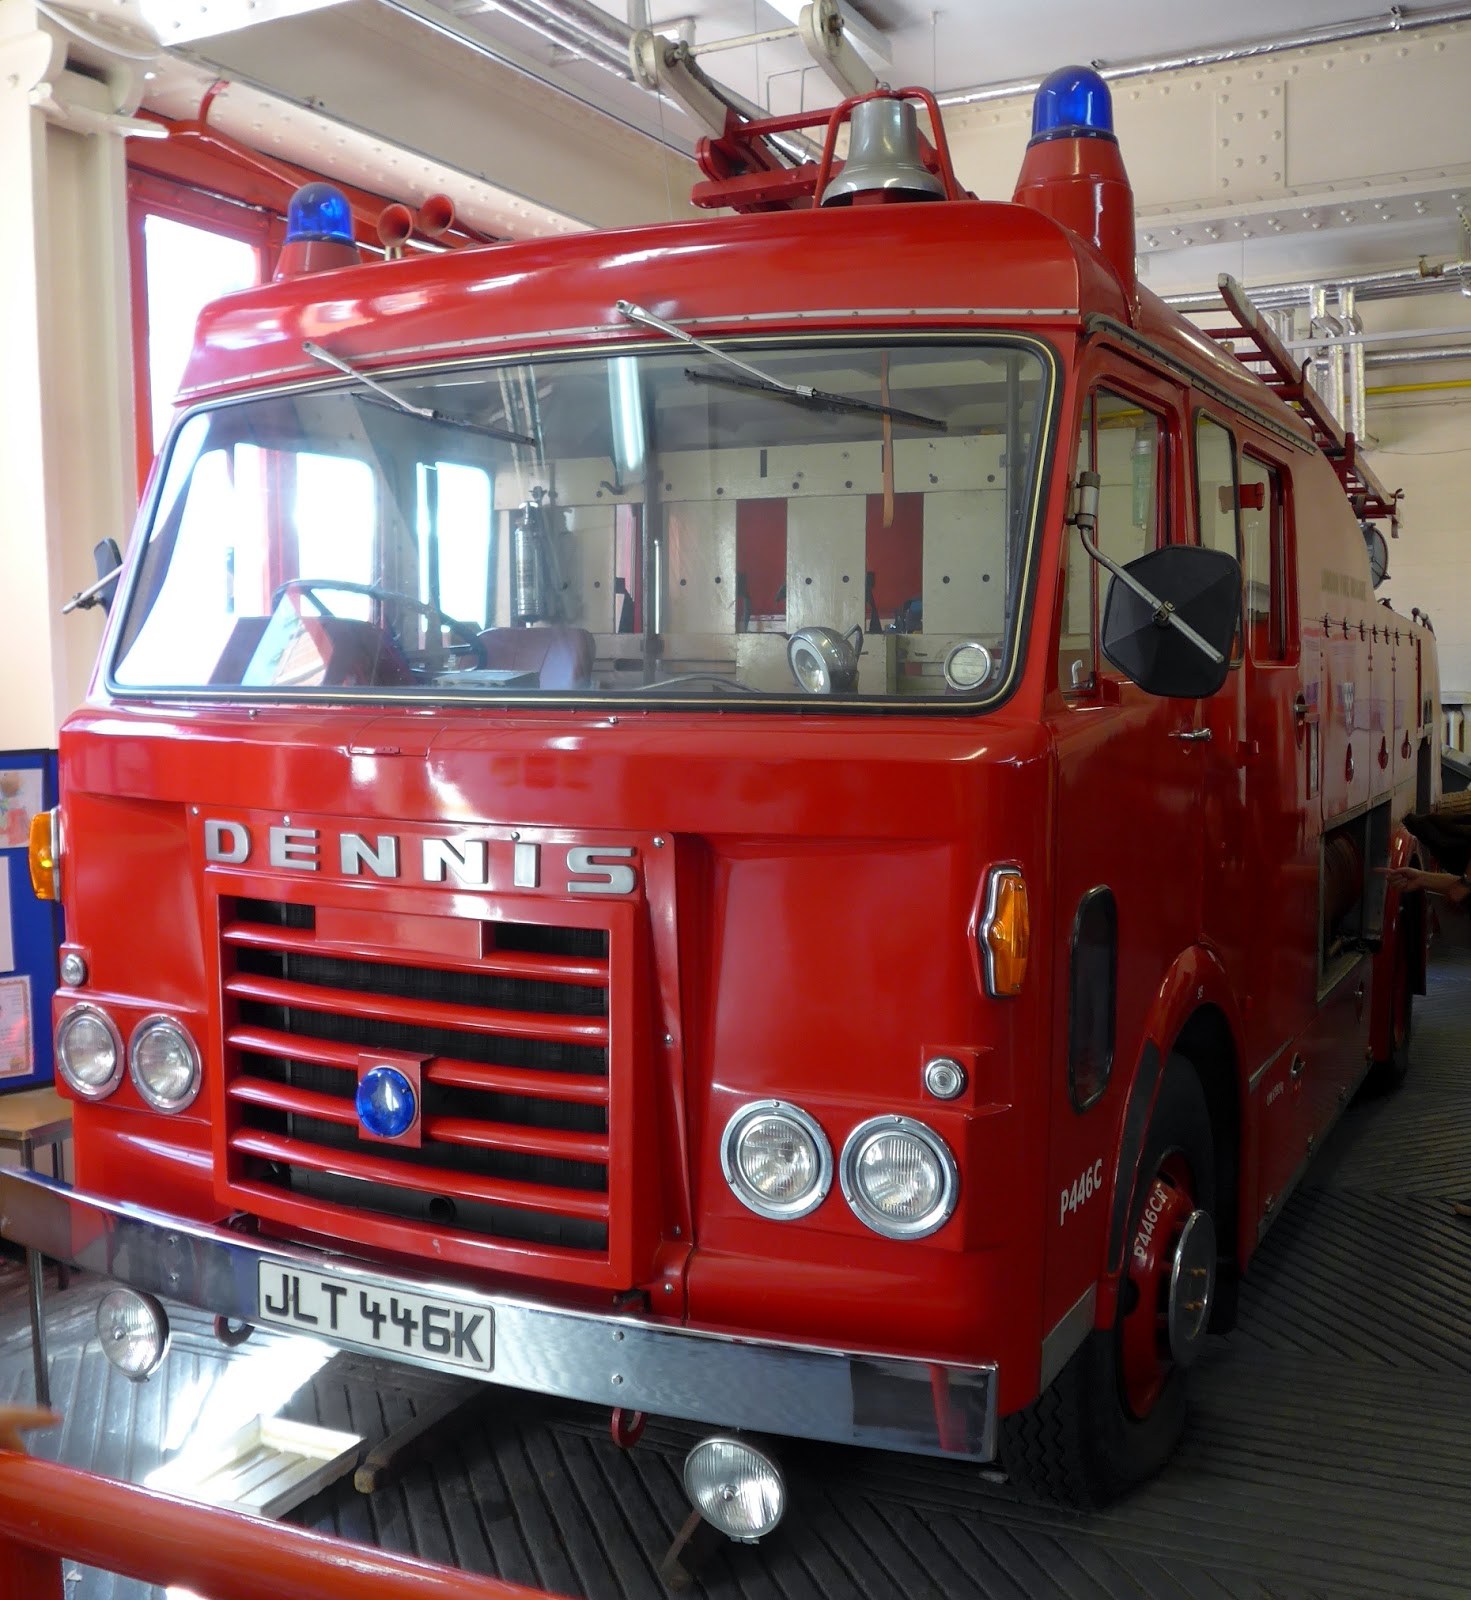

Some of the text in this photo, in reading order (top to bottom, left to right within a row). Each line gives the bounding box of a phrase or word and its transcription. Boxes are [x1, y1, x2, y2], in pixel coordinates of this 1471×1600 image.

[204, 818, 638, 896] DENNIS
[1060, 1158, 1103, 1227] P446C
[265, 1273, 485, 1362] JLT 446K
